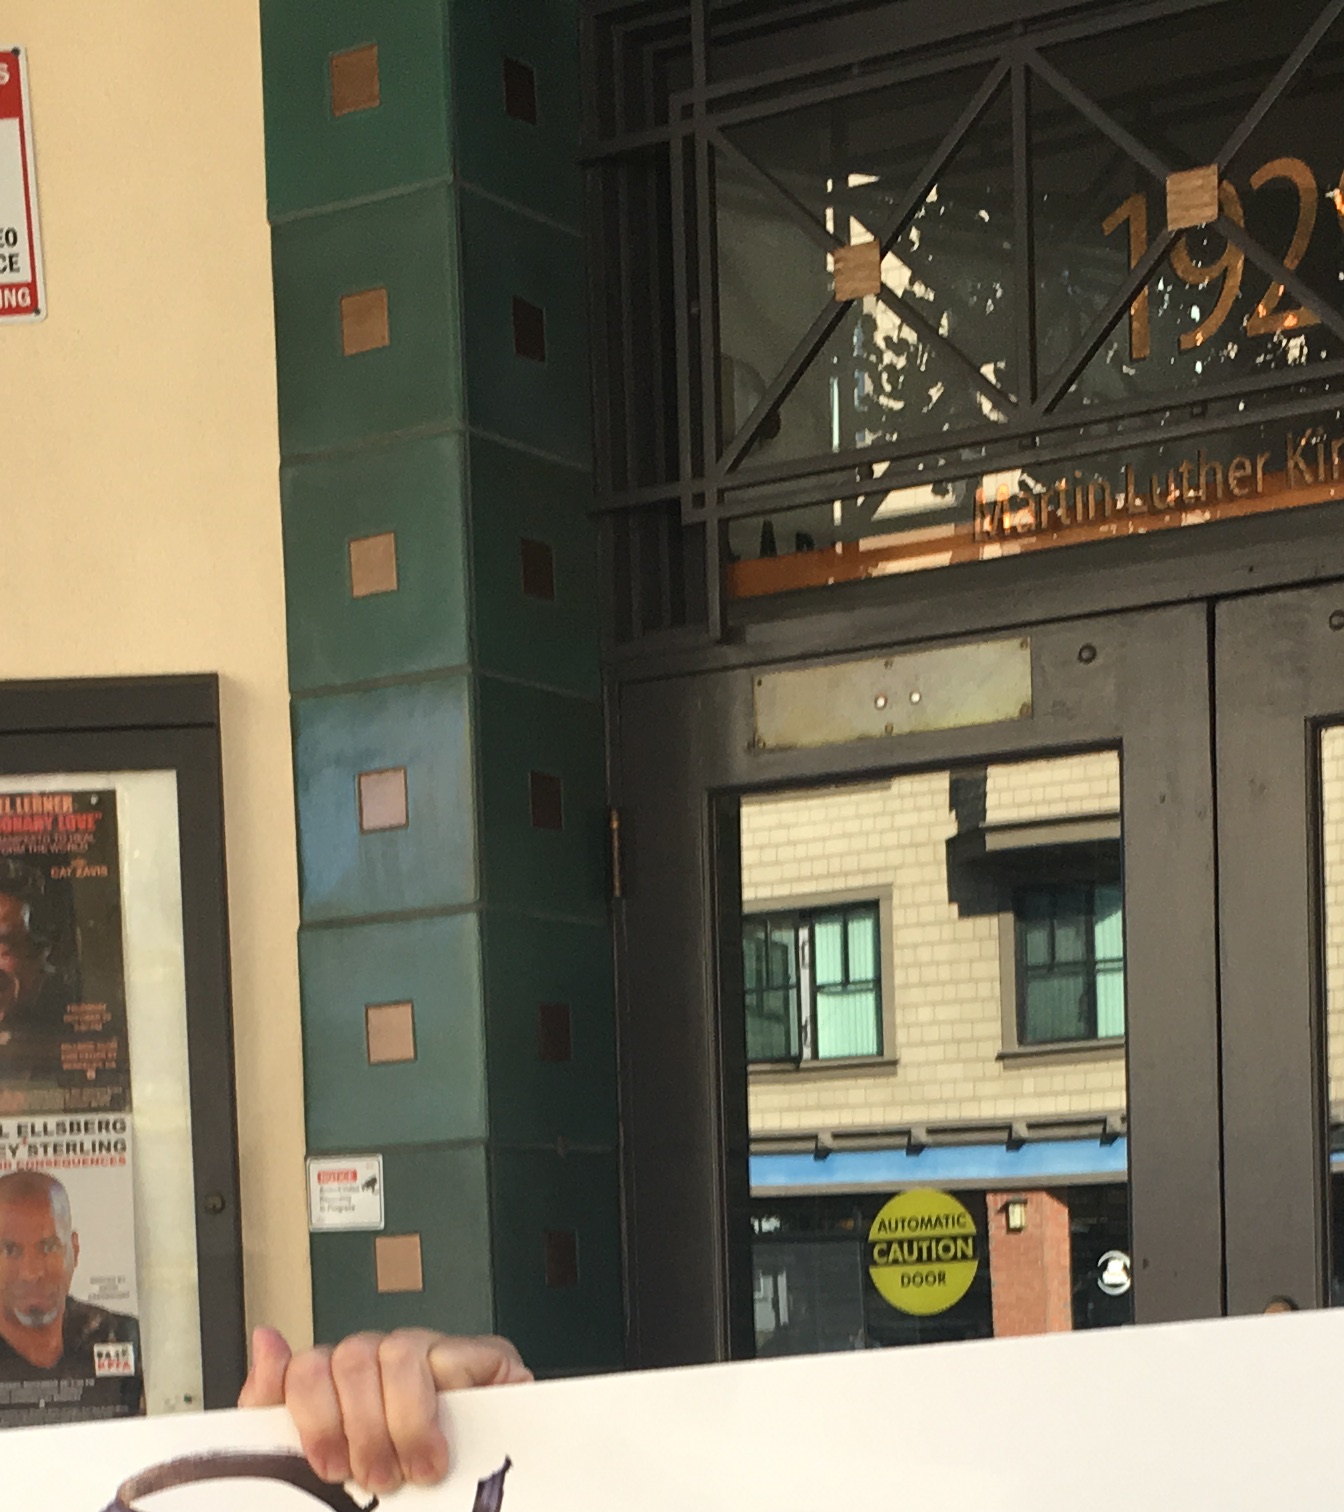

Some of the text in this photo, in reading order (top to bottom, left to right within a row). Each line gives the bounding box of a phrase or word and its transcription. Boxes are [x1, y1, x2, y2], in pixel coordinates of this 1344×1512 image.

[973, 468, 1112, 542] Martin
[1125, 450, 1268, 515] Luther
[17, 1118, 127, 1138] ELLSBERG
[27, 1138, 127, 1157] STERLING
[877, 1212, 967, 1234] AUTOMATIC
[873, 1238, 973, 1265] CAUTION
[900, 1270, 946, 1288] DOOR
